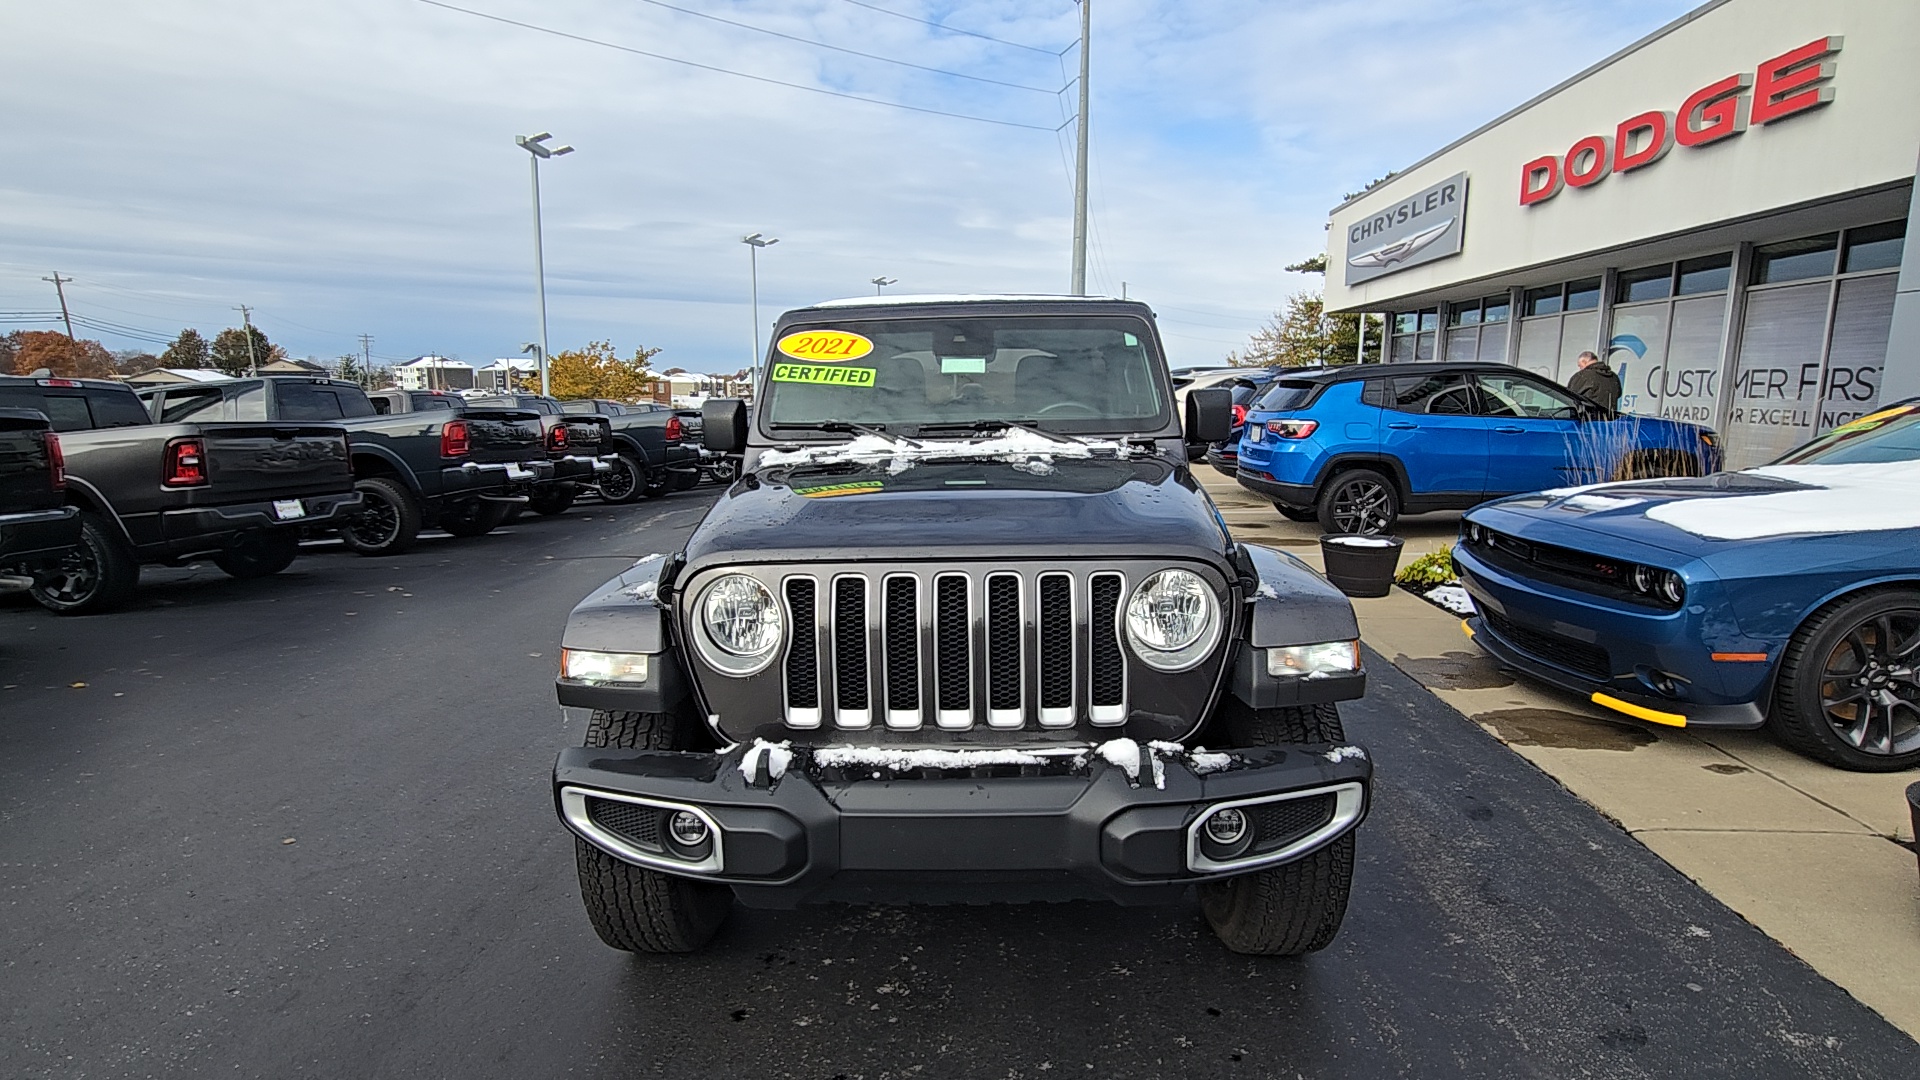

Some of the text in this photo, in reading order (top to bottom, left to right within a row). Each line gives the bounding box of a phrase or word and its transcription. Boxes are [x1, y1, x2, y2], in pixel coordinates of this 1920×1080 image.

[1519, 35, 1844, 207] DODGE
[1350, 183, 1456, 244] CHRYSLER
[793, 338, 858, 354] 2021
[775, 365, 871, 383] CERTIFIED
[1797, 363, 1885, 401] FIRS
[1663, 405, 1711, 421] AWARD
[1749, 408, 1864, 428] EXCELLNC
